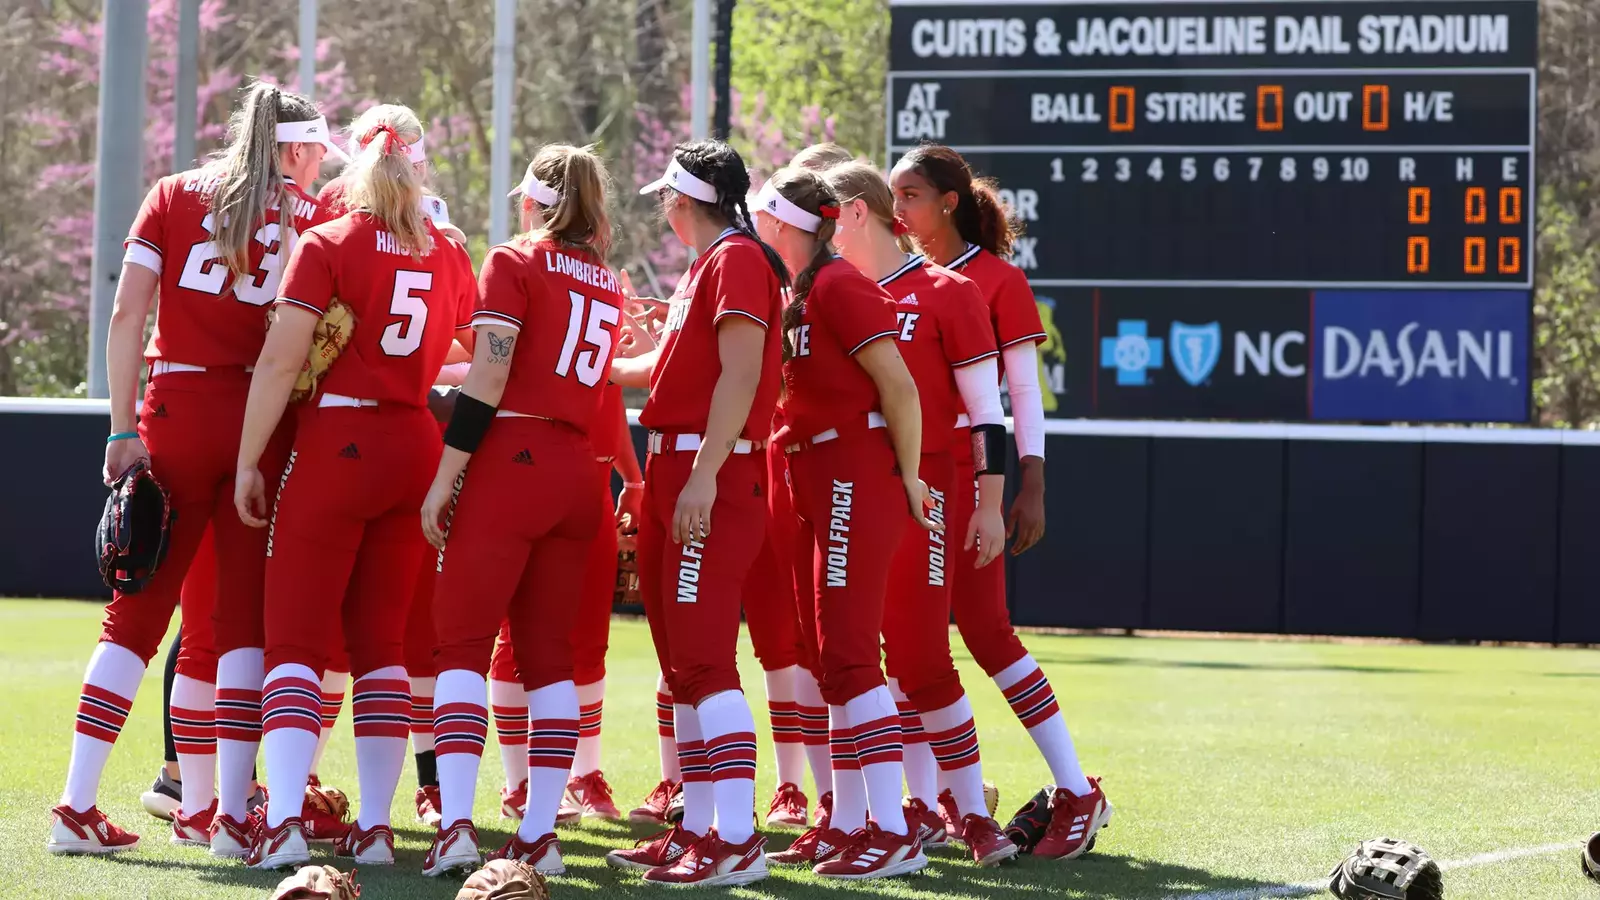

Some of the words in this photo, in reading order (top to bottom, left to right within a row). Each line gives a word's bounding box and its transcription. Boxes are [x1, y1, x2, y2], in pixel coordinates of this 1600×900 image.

[912, 19, 1027, 56] CURTIS
[1033, 18, 1062, 55] &
[1067, 16, 1267, 55] JACQUELINE
[1274, 16, 1350, 54] DAIL
[1357, 15, 1509, 53] STADIUM
[904, 83, 941, 110] AT
[1031, 93, 1101, 122] BALL
[1145, 92, 1246, 122] STRIKE
[1294, 92, 1352, 121] OUT
[1404, 92, 1454, 121] H/E
[897, 110, 951, 139] BAT
[1050, 157, 1065, 181] 1
[1081, 157, 1098, 181] 2
[1115, 157, 1131, 181] 3
[1147, 157, 1164, 181] 4
[1180, 157, 1197, 181] 5
[1213, 157, 1230, 181] 6
[1247, 157, 1262, 181] 7
[1280, 157, 1296, 181] 8
[1313, 157, 1329, 181] 9
[1340, 157, 1369, 181] 10
[1399, 157, 1416, 181] R
[1456, 157, 1473, 181] H
[1502, 157, 1518, 181] E
[1408, 187, 1430, 224] 0
[1464, 187, 1486, 224] 0
[1499, 187, 1521, 224] 0
[1407, 237, 1429, 273] 0
[1464, 237, 1486, 273] 0
[1498, 237, 1520, 273] 0
[379, 269, 433, 357] 5
[555, 289, 620, 388] 15
[1234, 331, 1306, 377] NC
[1324, 322, 1513, 386] DASANI
[826, 479, 854, 587] WOLFPACK
[928, 486, 945, 587] WOLFACK
[677, 515, 707, 603] WOLF
